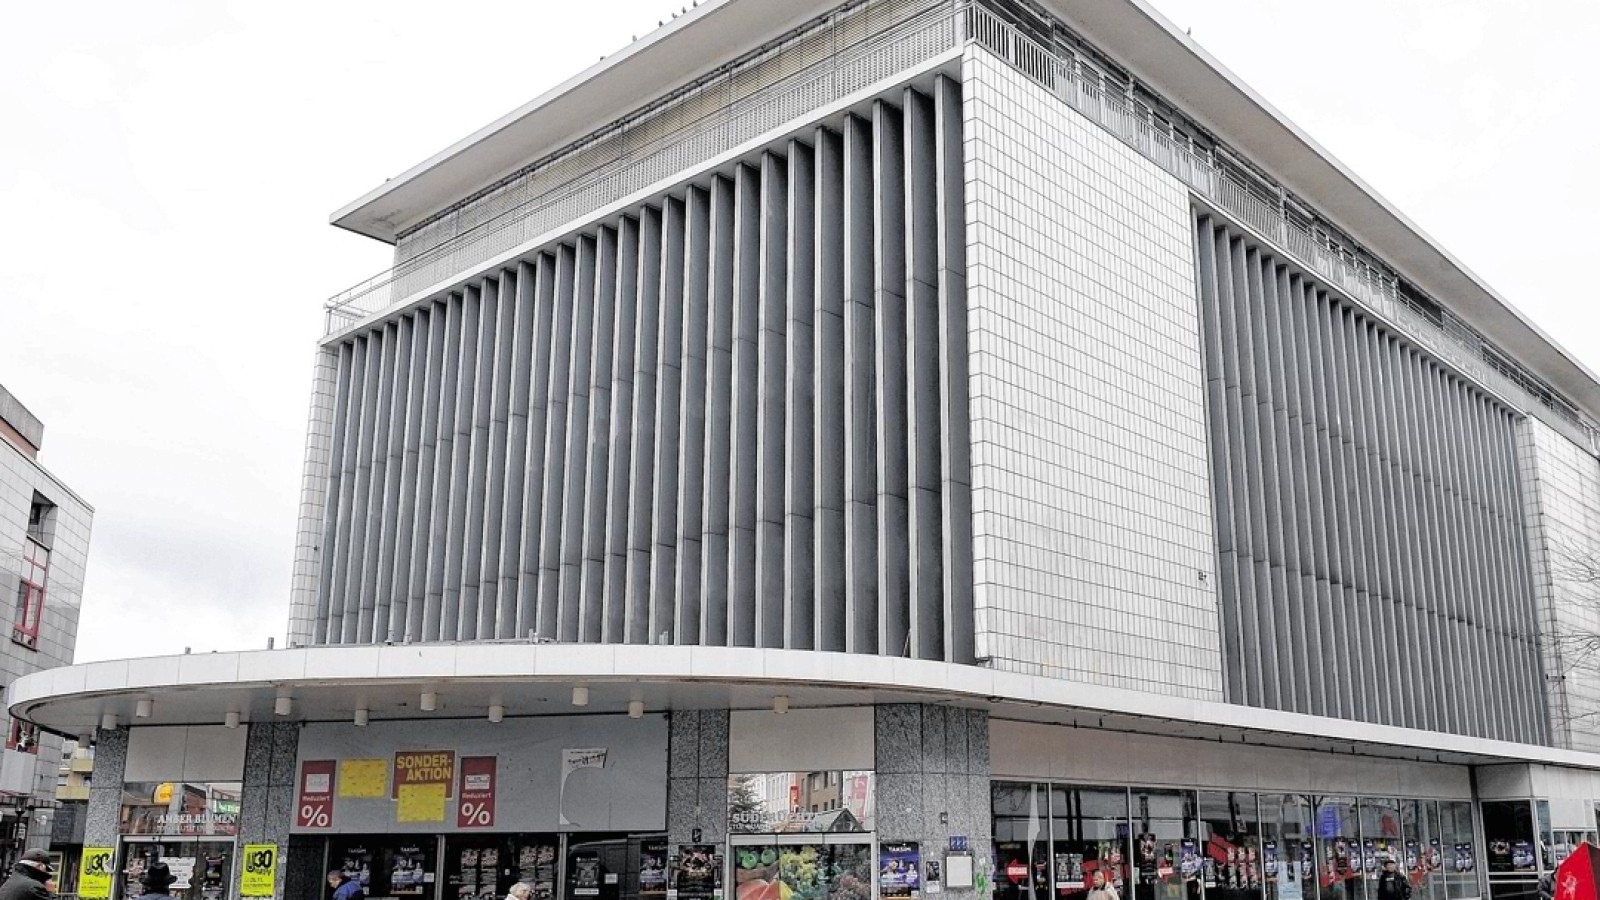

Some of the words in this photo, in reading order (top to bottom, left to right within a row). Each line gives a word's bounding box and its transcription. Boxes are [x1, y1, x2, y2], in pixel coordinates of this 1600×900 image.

[397, 754, 452, 769] SONDER-
[406, 767, 451, 781] AKTION
[157, 813, 192, 824] AMBER
[301, 804, 329, 827] %
[461, 802, 491, 825] %
